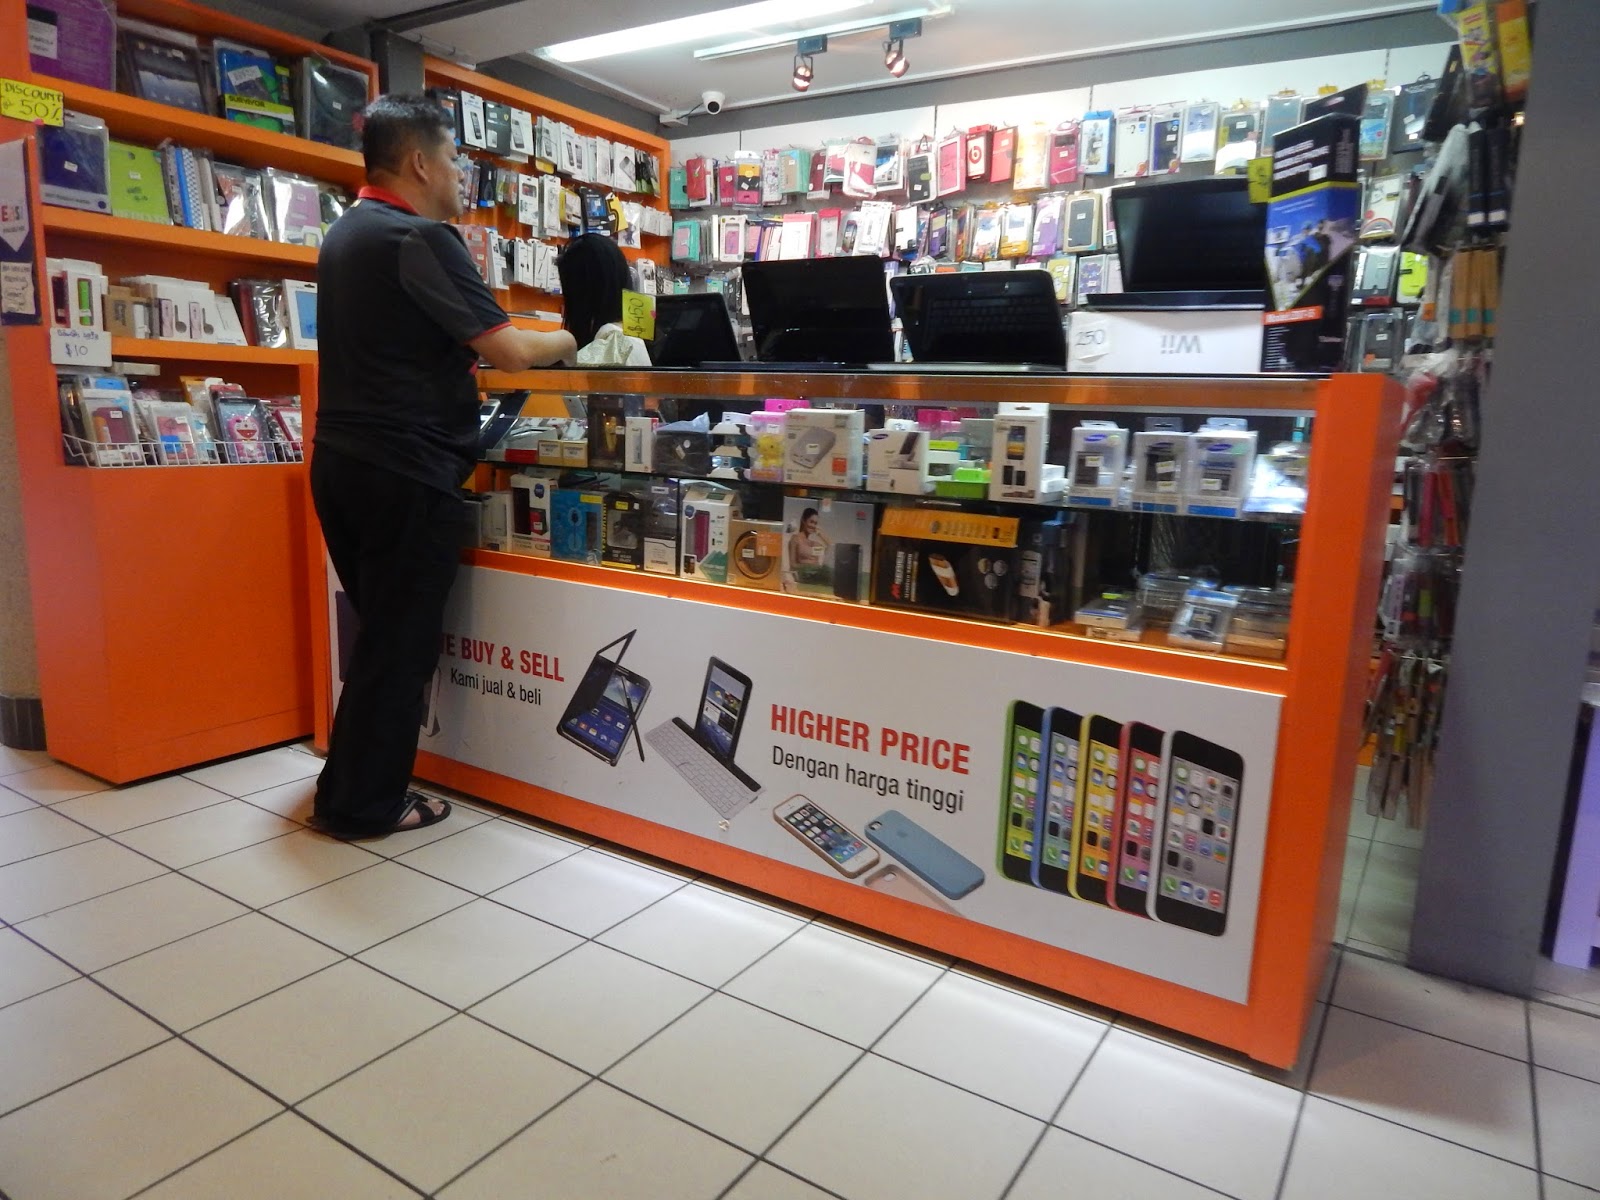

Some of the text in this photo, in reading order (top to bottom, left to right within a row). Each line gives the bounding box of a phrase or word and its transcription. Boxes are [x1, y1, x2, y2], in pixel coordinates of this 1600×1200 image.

[4, 82, 62, 103] DISCOUNT
[64, 342, 89, 358] $10
[1160, 334, 1202, 355] Wii
[438, 632, 565, 682] E BUY & SELL
[450, 667, 541, 706] Kami jual & beli
[771, 703, 970, 776] HIGHER PRICE
[772, 745, 965, 815] Dengan harga tinggi
